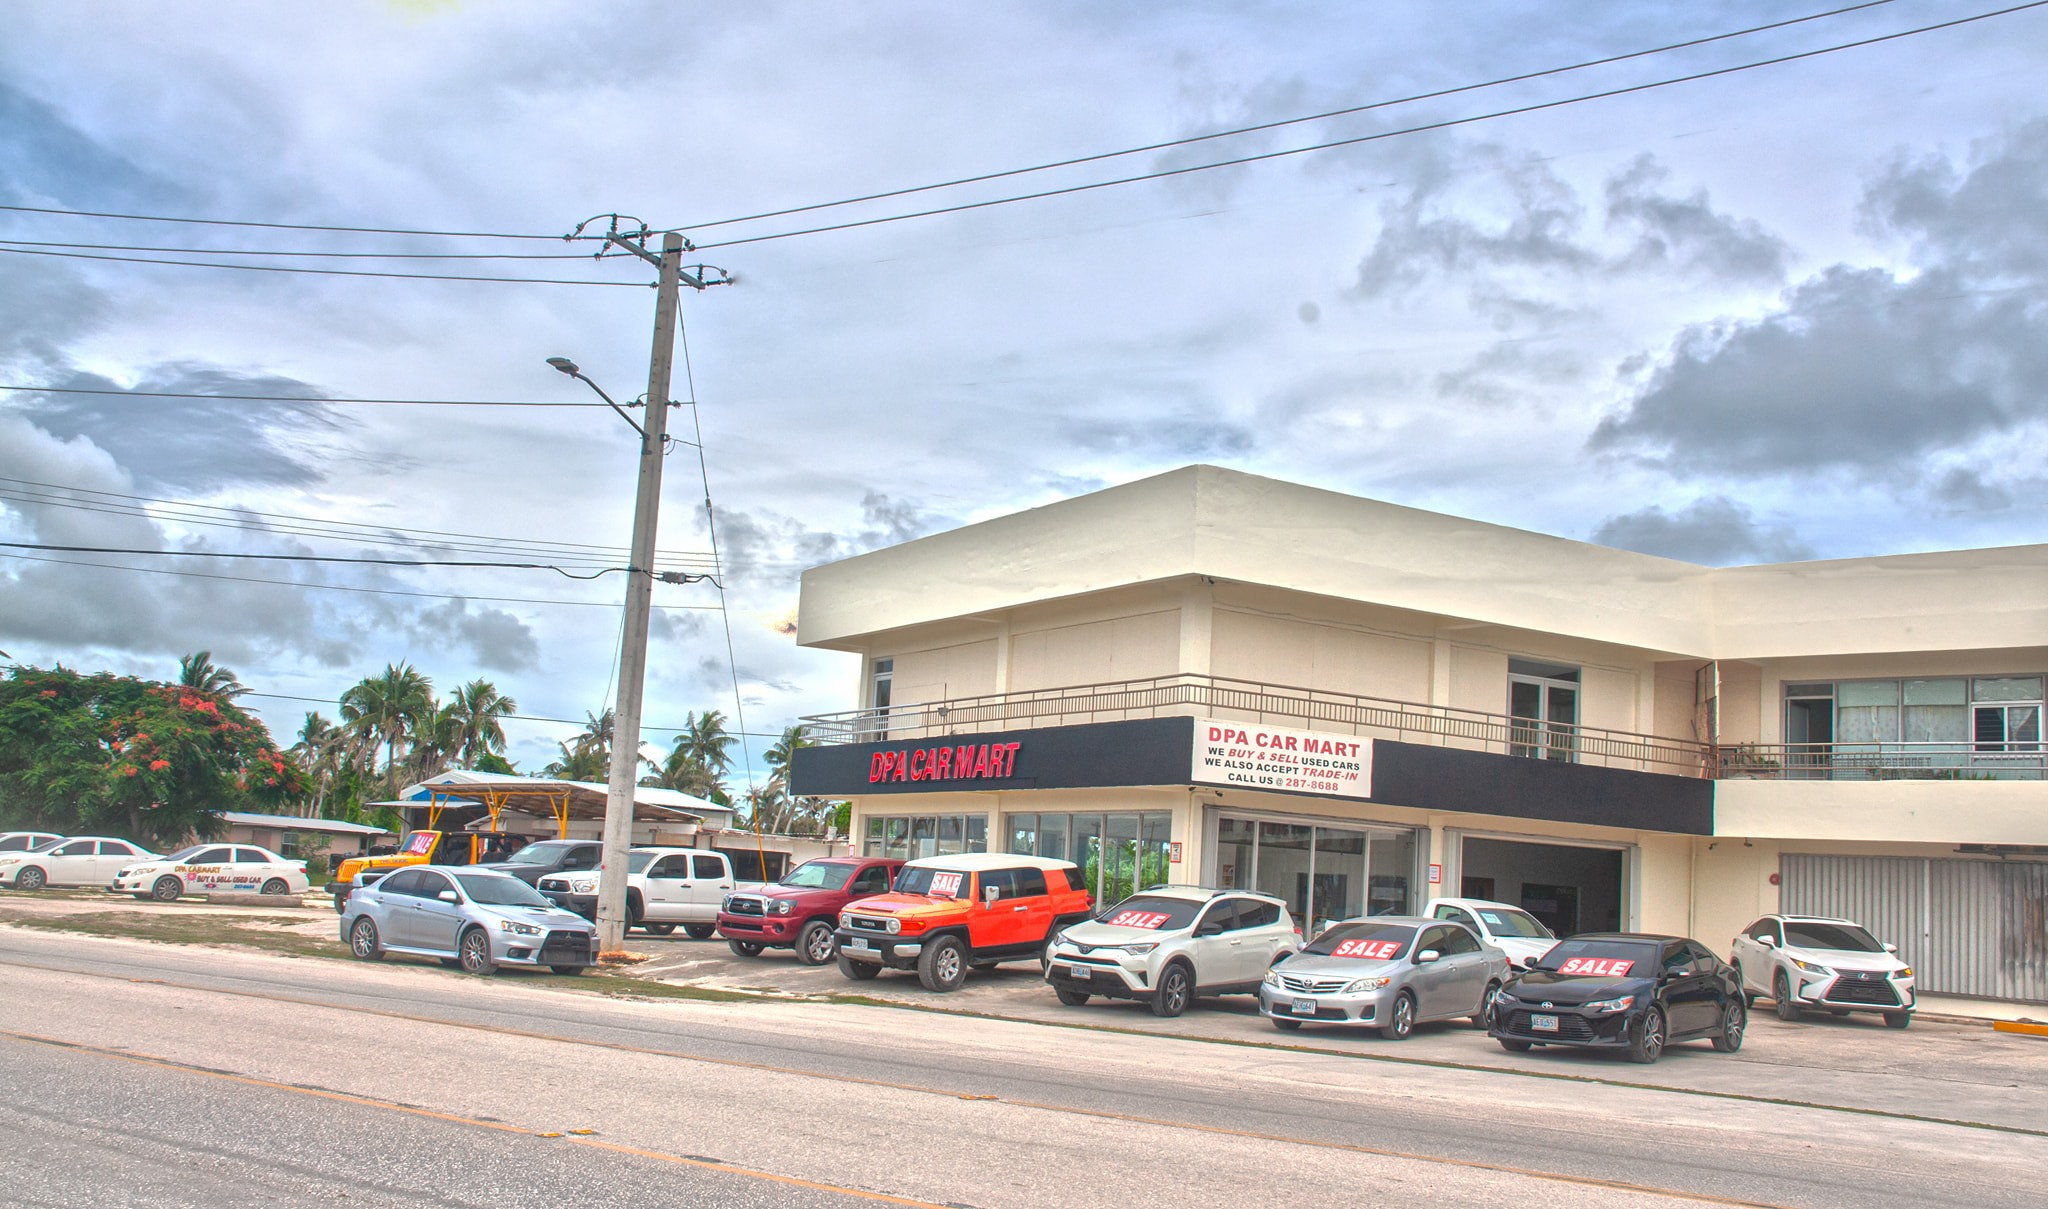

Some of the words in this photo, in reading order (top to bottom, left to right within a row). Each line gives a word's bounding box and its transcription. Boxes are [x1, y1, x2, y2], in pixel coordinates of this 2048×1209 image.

[1208, 727, 1249, 745] DPA
[1255, 733, 1298, 751] CAR
[1303, 738, 1361, 757] MART
[869, 751, 907, 783] DPA
[910, 747, 951, 781] CAR
[953, 742, 1020, 779] MART
[1208, 746, 1225, 756] WE
[1228, 748, 1255, 759] BUY
[1257, 751, 1266, 760] &
[1269, 753, 1299, 764] SELL
[1301, 757, 1330, 767] USED
[1332, 760, 1361, 771] CARS
[1205, 757, 1222, 767] WE
[1224, 760, 1254, 770] ALSO
[1256, 763, 1299, 775] ACCEPT
[1302, 767, 1359, 781] TRADE-IN
[1228, 773, 1256, 783] CALL
[1259, 776, 1274, 785] US
[1276, 777, 1284, 787] @
[1285, 778, 1339, 791] 287-8688
[411, 834, 435, 854] SALE
[932, 875, 960, 891] SALE
[1113, 911, 1165, 929] SALE
[1336, 941, 1396, 958] SALE
[1562, 959, 1629, 975] SALE
